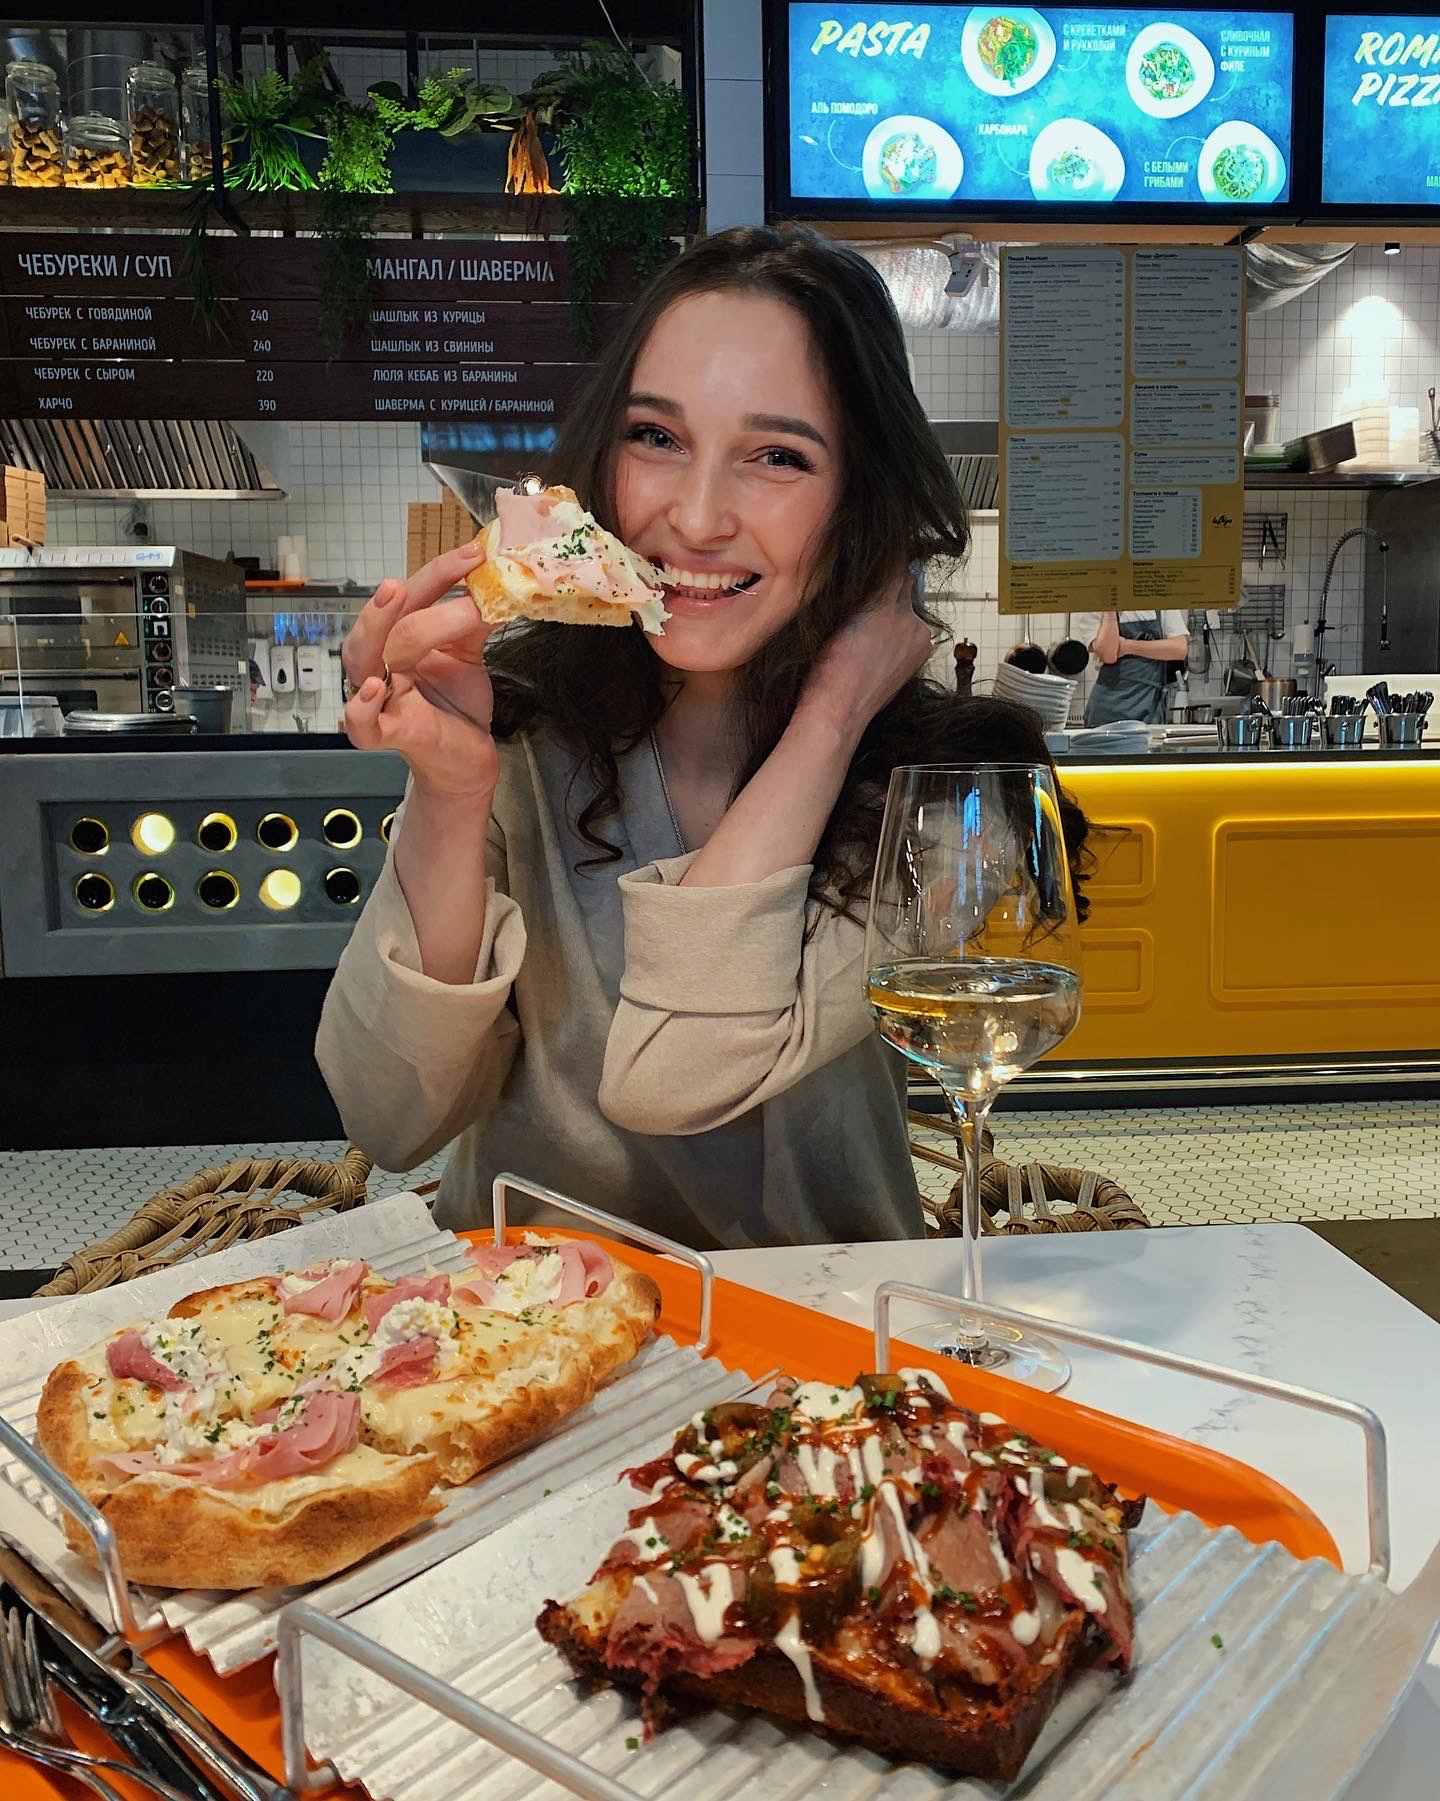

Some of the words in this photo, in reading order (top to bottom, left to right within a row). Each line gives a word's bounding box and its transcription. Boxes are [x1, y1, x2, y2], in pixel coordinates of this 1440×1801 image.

[810, 20, 931, 59] PASTA
[1220, 30, 1271, 43] СЛИВОЧНАЯ
[1220, 45, 1227, 57] С
[1228, 45, 1271, 57] КУРИНЫМ
[1220, 60, 1245, 72] ФИЛЕ
[811, 102, 829, 114] АЛЬ
[831, 102, 879, 116] ПОМОДОРО
[978, 123, 1028, 135] КАРБОНАРА
[1144, 161, 1150, 173] С
[1151, 161, 1189, 174] БЕЛЫМИ
[1144, 176, 1184, 188] ГРИБАМИ
[1426, 175, 1440, 187] МА
[18, 254, 118, 277] ЧЕБУРЕКИ
[135, 255, 172, 278] СУП
[366, 258, 443, 280] МАНГАЛ
[25, 307, 72, 319] ЧЕБУРЕК
[76, 307, 84, 320] С
[88, 306, 152, 322] ГОВЯДИНОЙ
[250, 309, 269, 321] 240
[424, 311, 438, 323] ИЗ
[443, 311, 485, 324] КУРИЦЫ
[30, 337, 77, 350] ЧЕБУРЕК
[81, 338, 88, 350] С
[92, 337, 156, 351] БАРАНИНОЙ
[253, 340, 272, 352] 240
[371, 340, 421, 352] ШАШЛЫК
[425, 340, 439, 352] ИЗ
[443, 341, 494, 353] СВИНИНЫ
[34, 367, 80, 380] ЧЕБУРЕК
[84, 368, 92, 380] С
[96, 368, 135, 381] СЫРОМ
[256, 370, 274, 382] 220
[373, 370, 403, 382] ЛЮЛЯ
[408, 370, 439, 382] КЕБАБ
[444, 371, 458, 382] ИЗ
[462, 371, 517, 383] БАРАНИНЫ
[38, 397, 73, 410] ХАРЧО
[258, 399, 276, 411] 390
[375, 399, 425, 411] ШАВЕРМА
[430, 399, 436, 411] С
